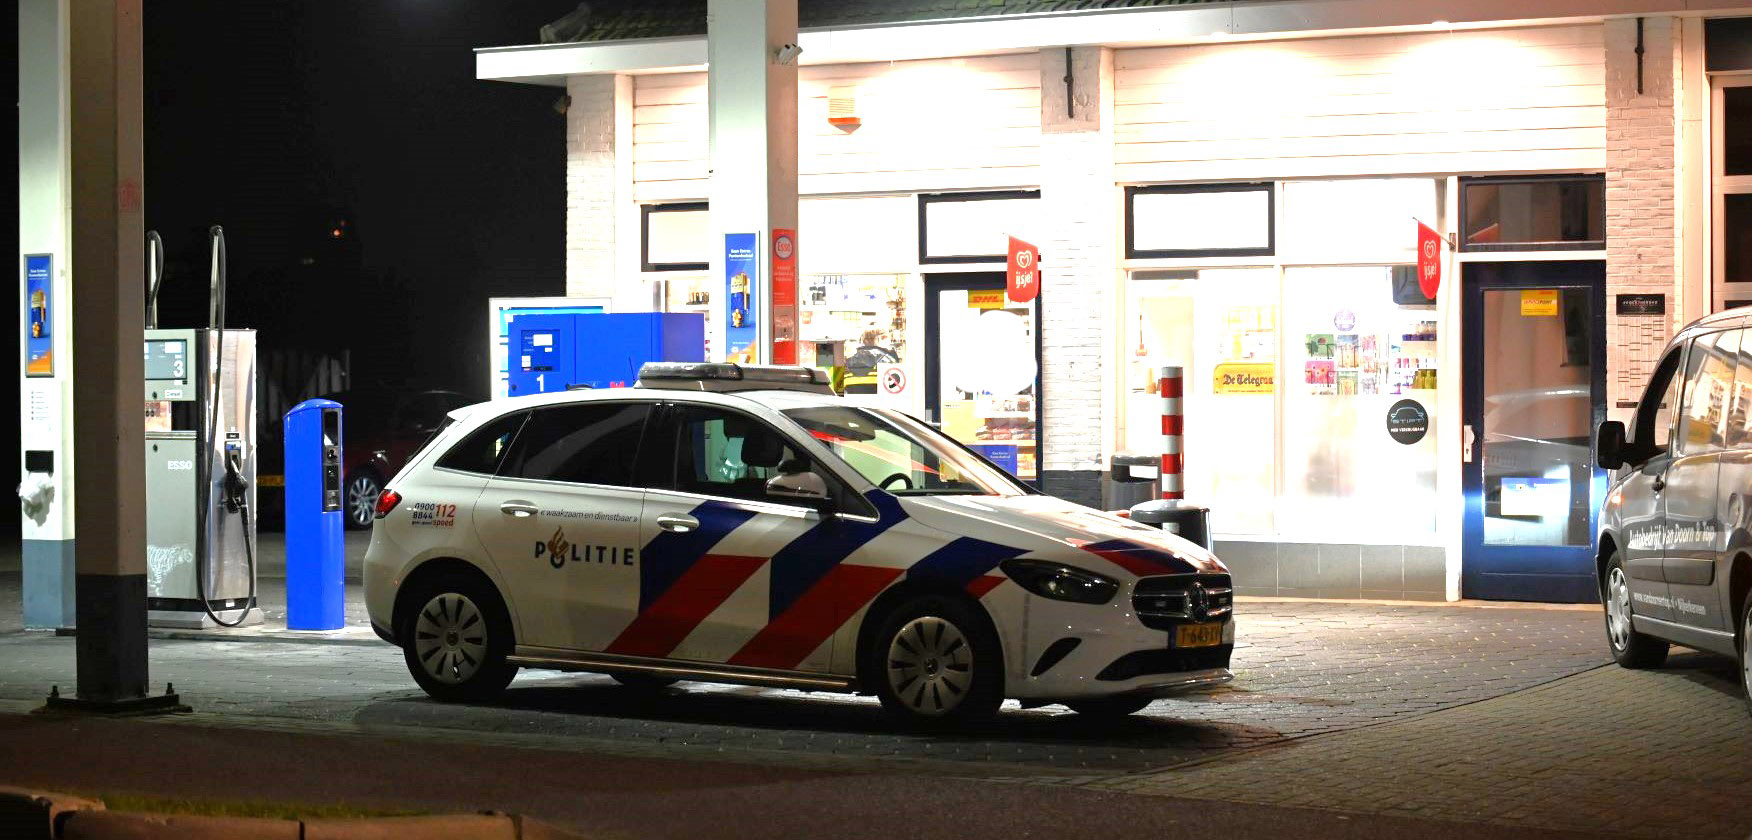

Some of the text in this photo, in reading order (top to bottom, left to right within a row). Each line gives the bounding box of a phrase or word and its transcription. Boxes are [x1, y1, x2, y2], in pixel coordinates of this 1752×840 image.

[173, 360, 184, 378] 3
[536, 374, 545, 392] 1
[1223, 373, 1274, 387] De Telegraa
[167, 460, 193, 470] ESSO
[414, 502, 436, 511] 0900
[435, 503, 457, 518] 112
[412, 511, 433, 519] 8844
[546, 509, 584, 519] waakzaam
[594, 512, 633, 522] dienstbaar
[1628, 524, 1662, 550] Autobedrijf
[1662, 525, 1675, 545] Van
[1674, 523, 1695, 544] Doorn
[1702, 521, 1716, 547] Top
[534, 541, 635, 569] POLITIE
